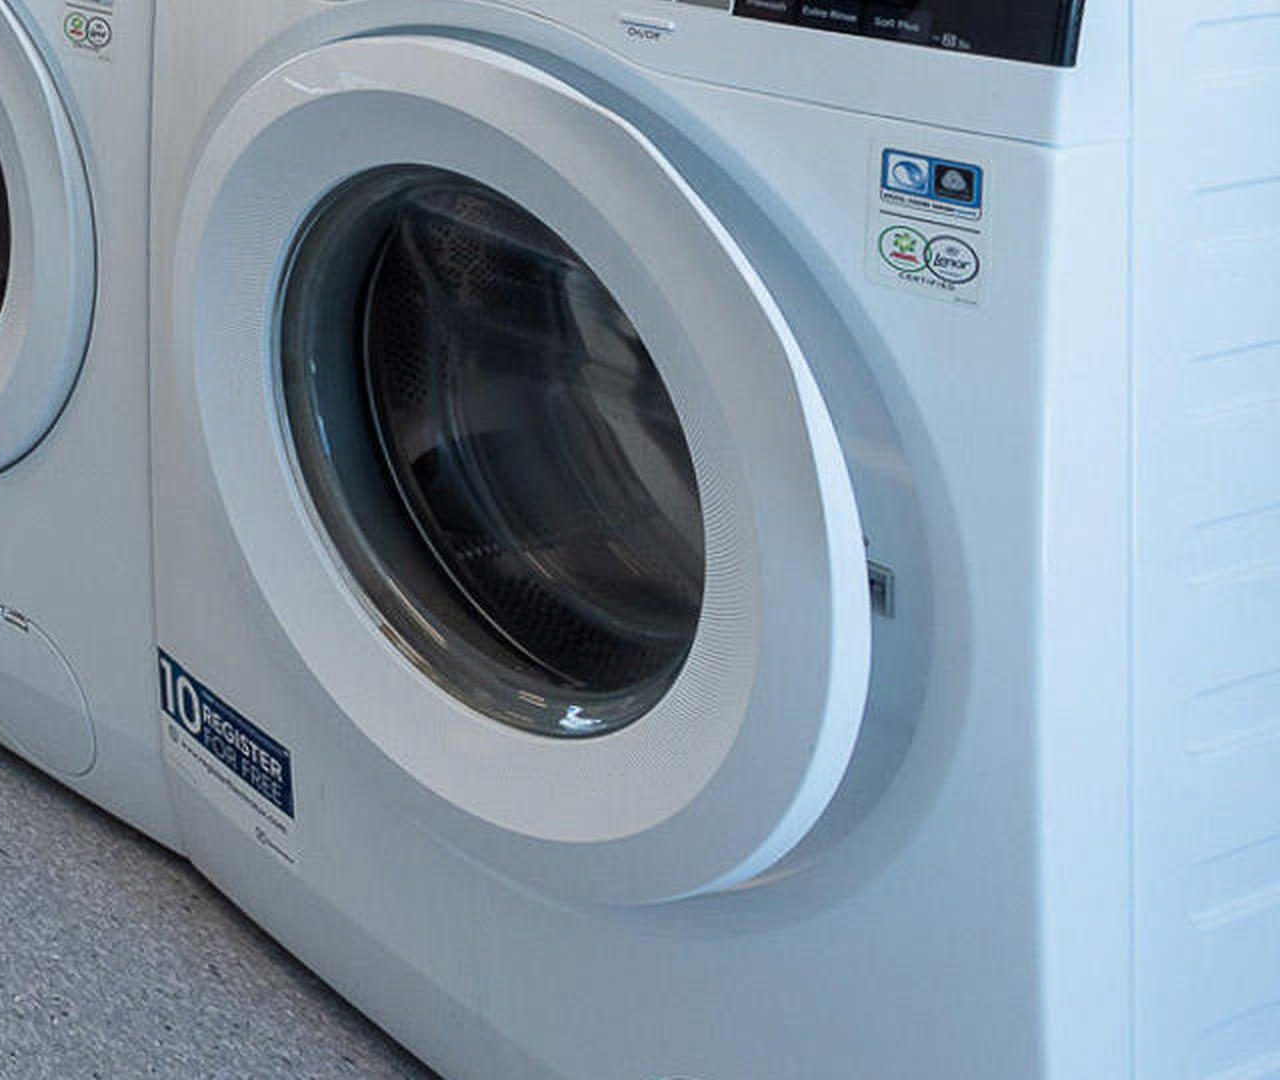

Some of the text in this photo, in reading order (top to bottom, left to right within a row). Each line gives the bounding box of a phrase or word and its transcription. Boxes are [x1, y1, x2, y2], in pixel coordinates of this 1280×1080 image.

[159, 657, 202, 735] 10
[202, 703, 284, 782] REGISTER
[203, 726, 239, 770] FOR
[241, 759, 284, 807] FREE
